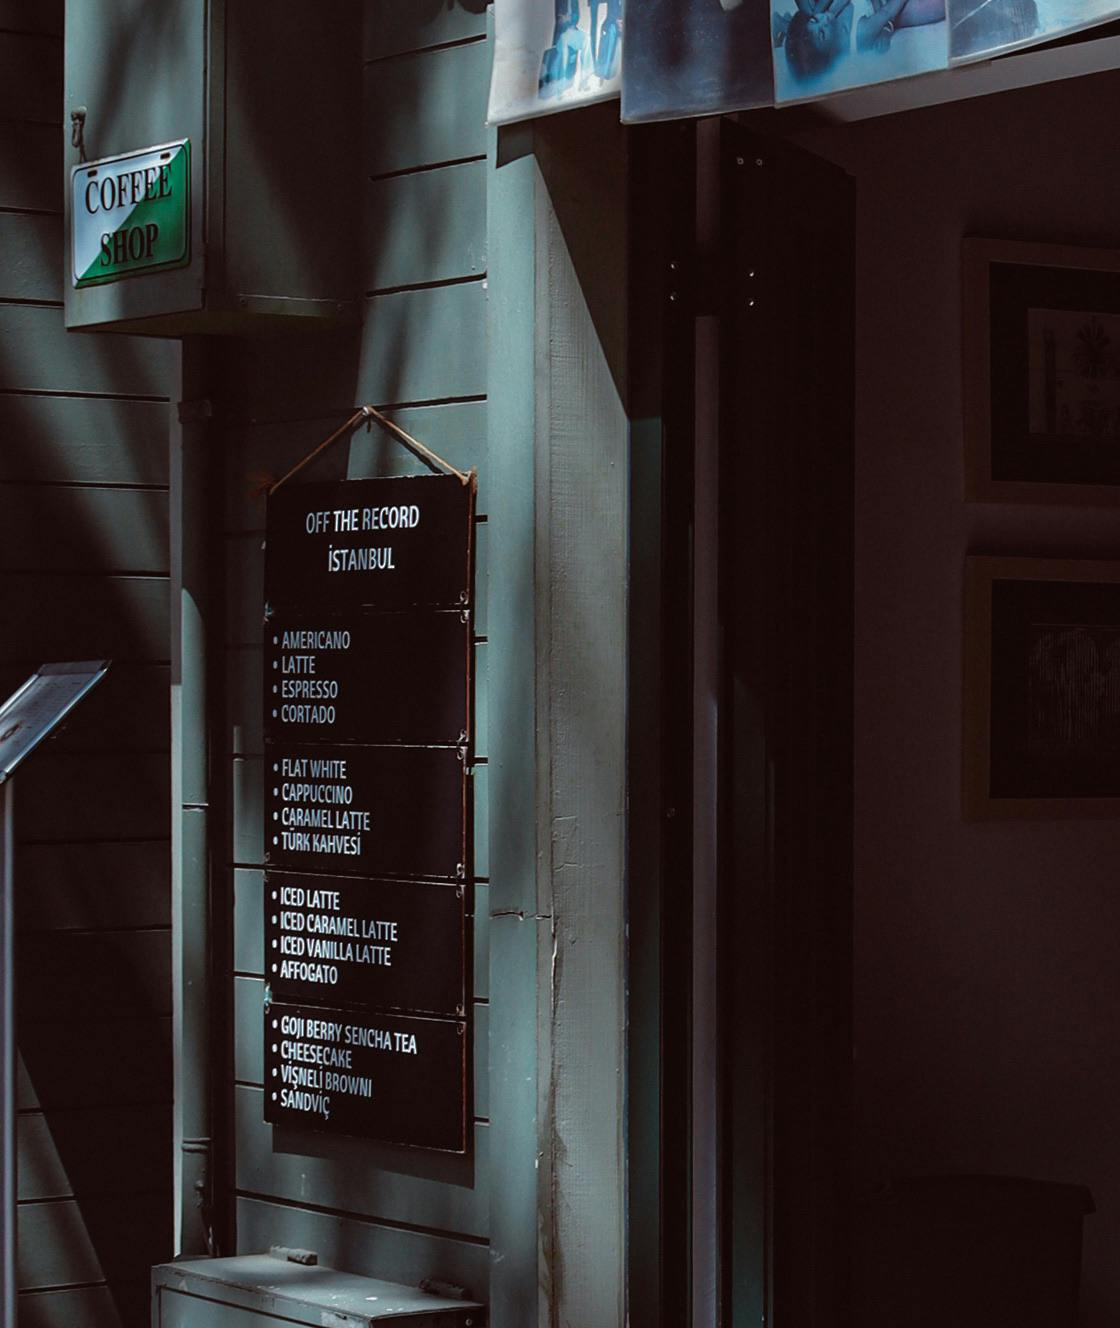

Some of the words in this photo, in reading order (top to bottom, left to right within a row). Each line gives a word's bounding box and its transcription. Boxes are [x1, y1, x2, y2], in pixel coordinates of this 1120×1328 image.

[85, 163, 172, 214] COFFEE
[100, 223, 159, 267] SHOP
[306, 511, 331, 535] OFF
[333, 508, 360, 533] THE
[362, 504, 421, 530] RECORD
[328, 544, 396, 572] İSTANBUL
[282, 630, 351, 650] AMERICANO
[282, 655, 316, 674] LATTE
[282, 679, 339, 699] ESPRESSO
[281, 704, 336, 724] CORTADO
[282, 758, 309, 779] FLAT
[310, 760, 347, 780] WHITE
[282, 783, 353, 805] CAPPUCCINO
[282, 807, 334, 830] CARAMEL
[335, 810, 371, 832] LATTE
[280, 887, 305, 910] ICED
[306, 889, 340, 911] LATTE
[280, 911, 305, 933] ICED
[306, 915, 361, 939] CARAMEL
[362, 921, 398, 943] LATTE
[280, 935, 305, 957] ICED
[306, 938, 354, 963] VANILLA
[355, 944, 392, 967] LATTE
[280, 960, 338, 985] AFFOGATO
[280, 1015, 305, 1040] GOJI
[306, 1018, 343, 1044] BERRY
[344, 1022, 392, 1051] SENCHA
[393, 1032, 418, 1056] TEA
[280, 1039, 353, 1070] CHEESECAKE
[325, 1073, 373, 1099] BROWNI
